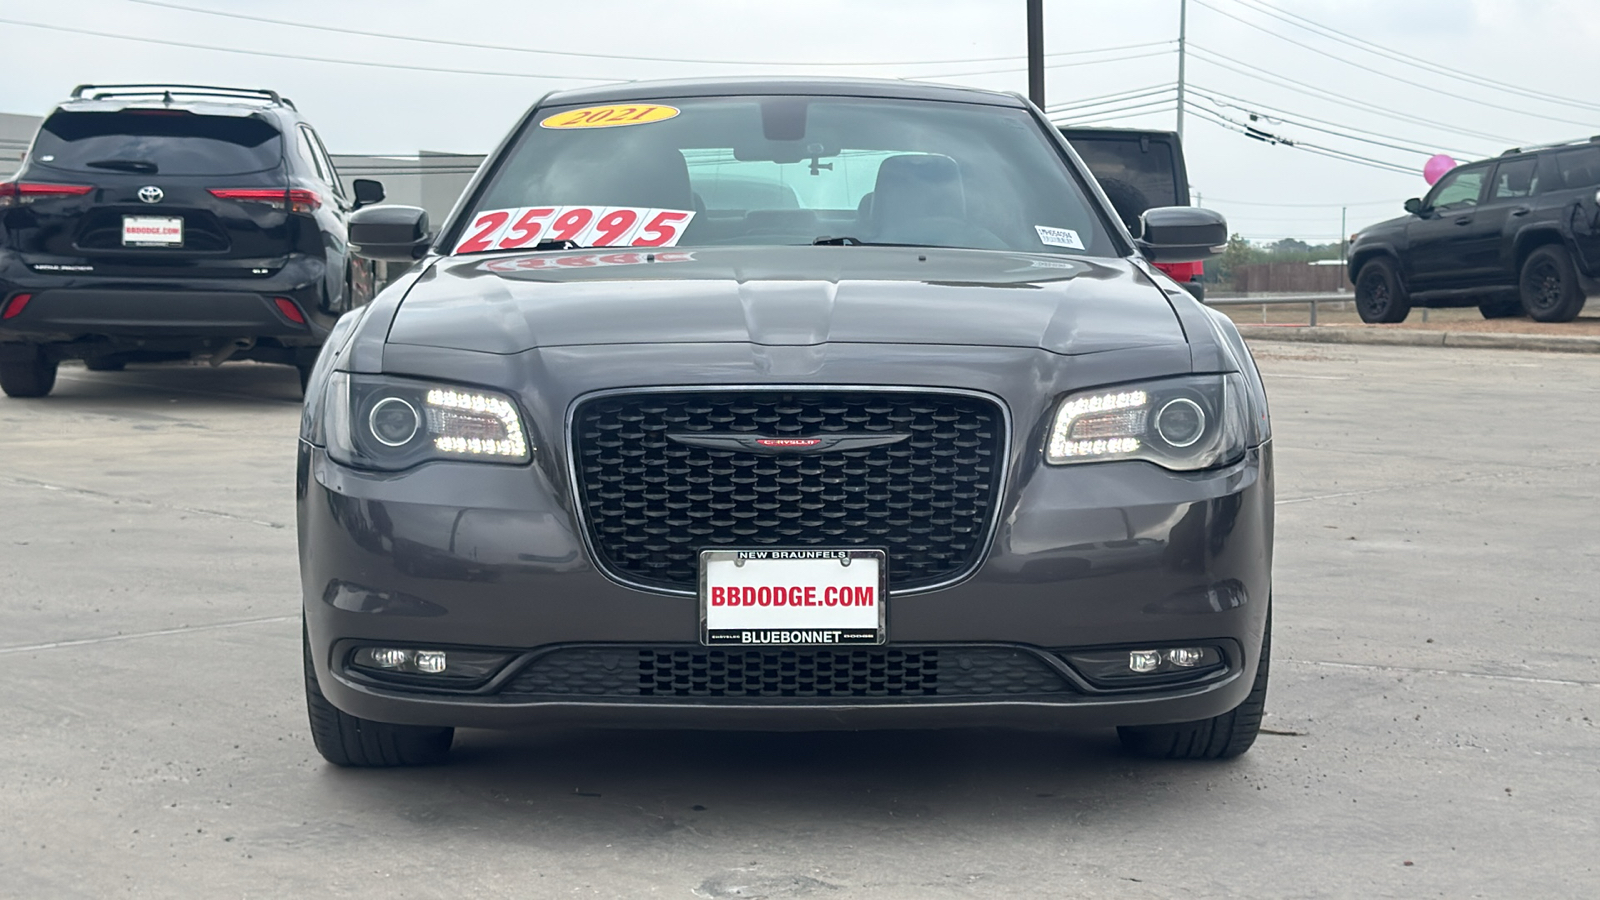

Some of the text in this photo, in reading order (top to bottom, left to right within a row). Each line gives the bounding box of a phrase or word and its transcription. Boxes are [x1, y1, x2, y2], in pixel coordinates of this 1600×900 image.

[560, 107, 658, 126] 2021
[456, 208, 690, 254] 25995
[739, 551, 846, 559] NEW BRAUNFELS
[711, 586, 874, 607] BBDODGE.COM
[741, 631, 842, 644] BLUEBONNET
